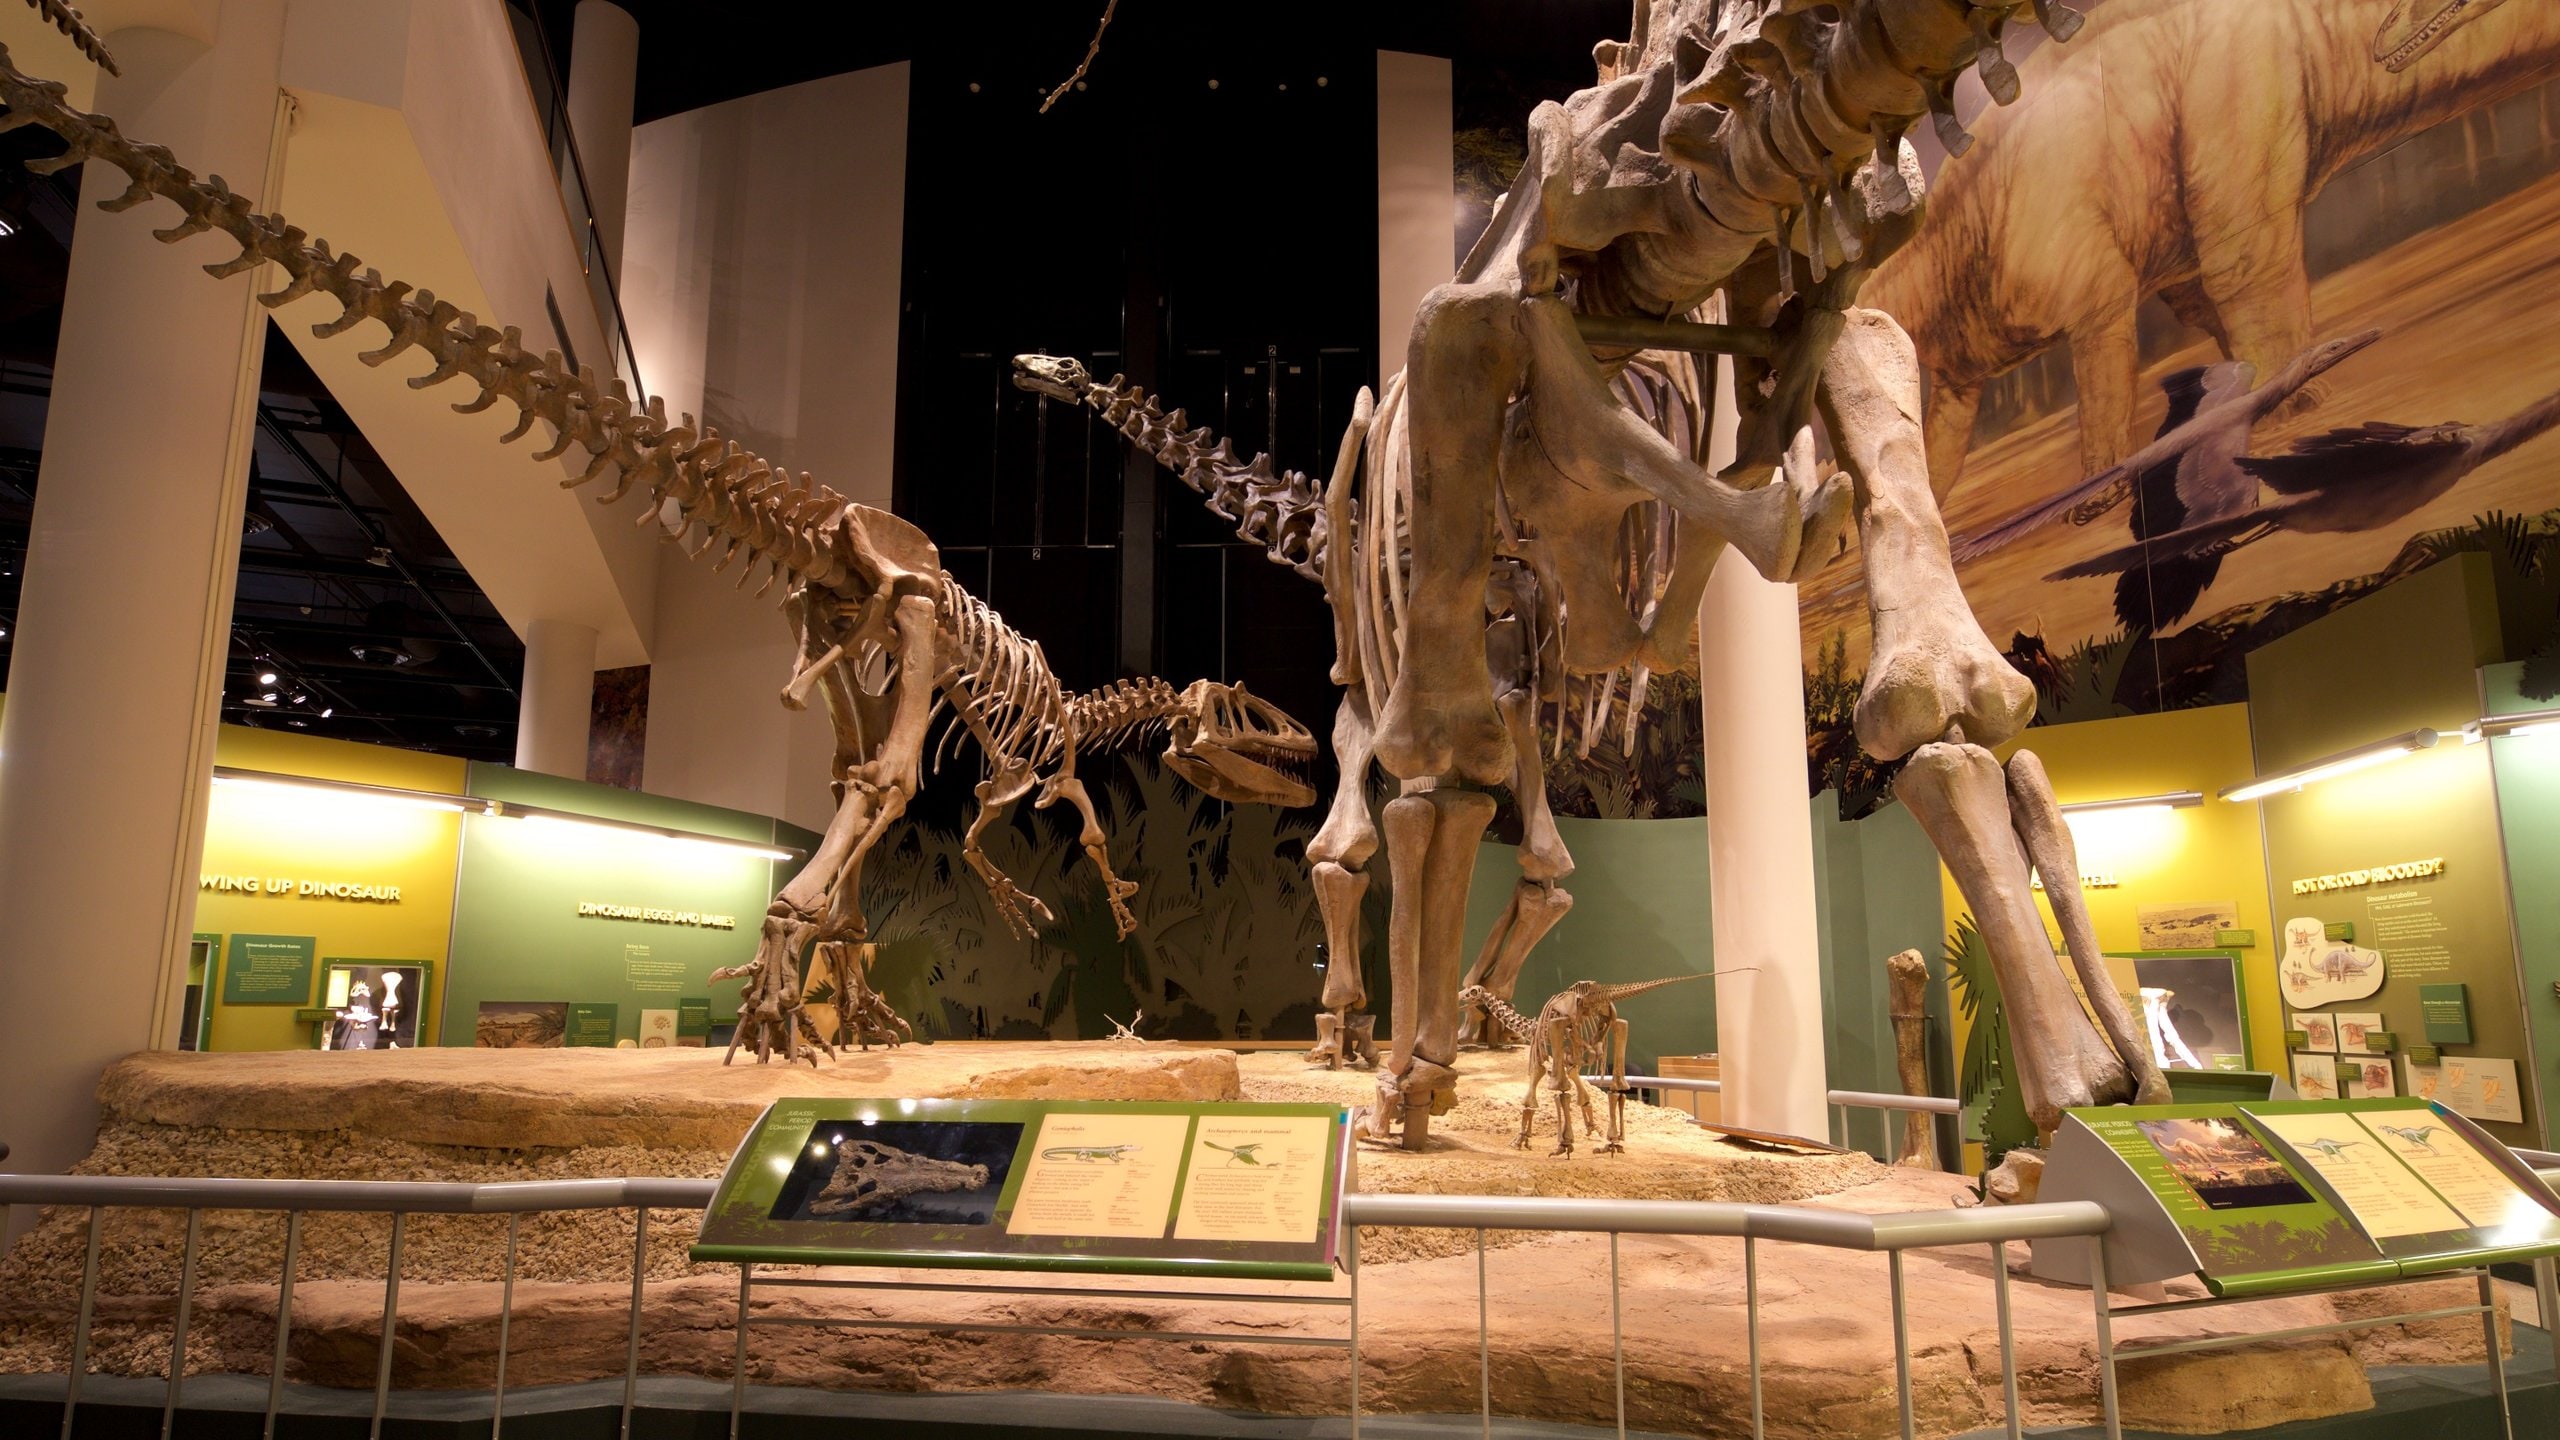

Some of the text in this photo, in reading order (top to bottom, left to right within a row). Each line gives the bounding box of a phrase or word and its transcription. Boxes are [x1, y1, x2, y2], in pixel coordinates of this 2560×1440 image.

[265, 877, 294, 894] UP
[299, 880, 401, 901] DINOSAUR
[2292, 877, 2318, 895] HOT
[2317, 874, 2338, 891] OR
[2336, 869, 2371, 888] COLD
[578, 901, 736, 928] DINOSAUR EGGS AND BABIES
